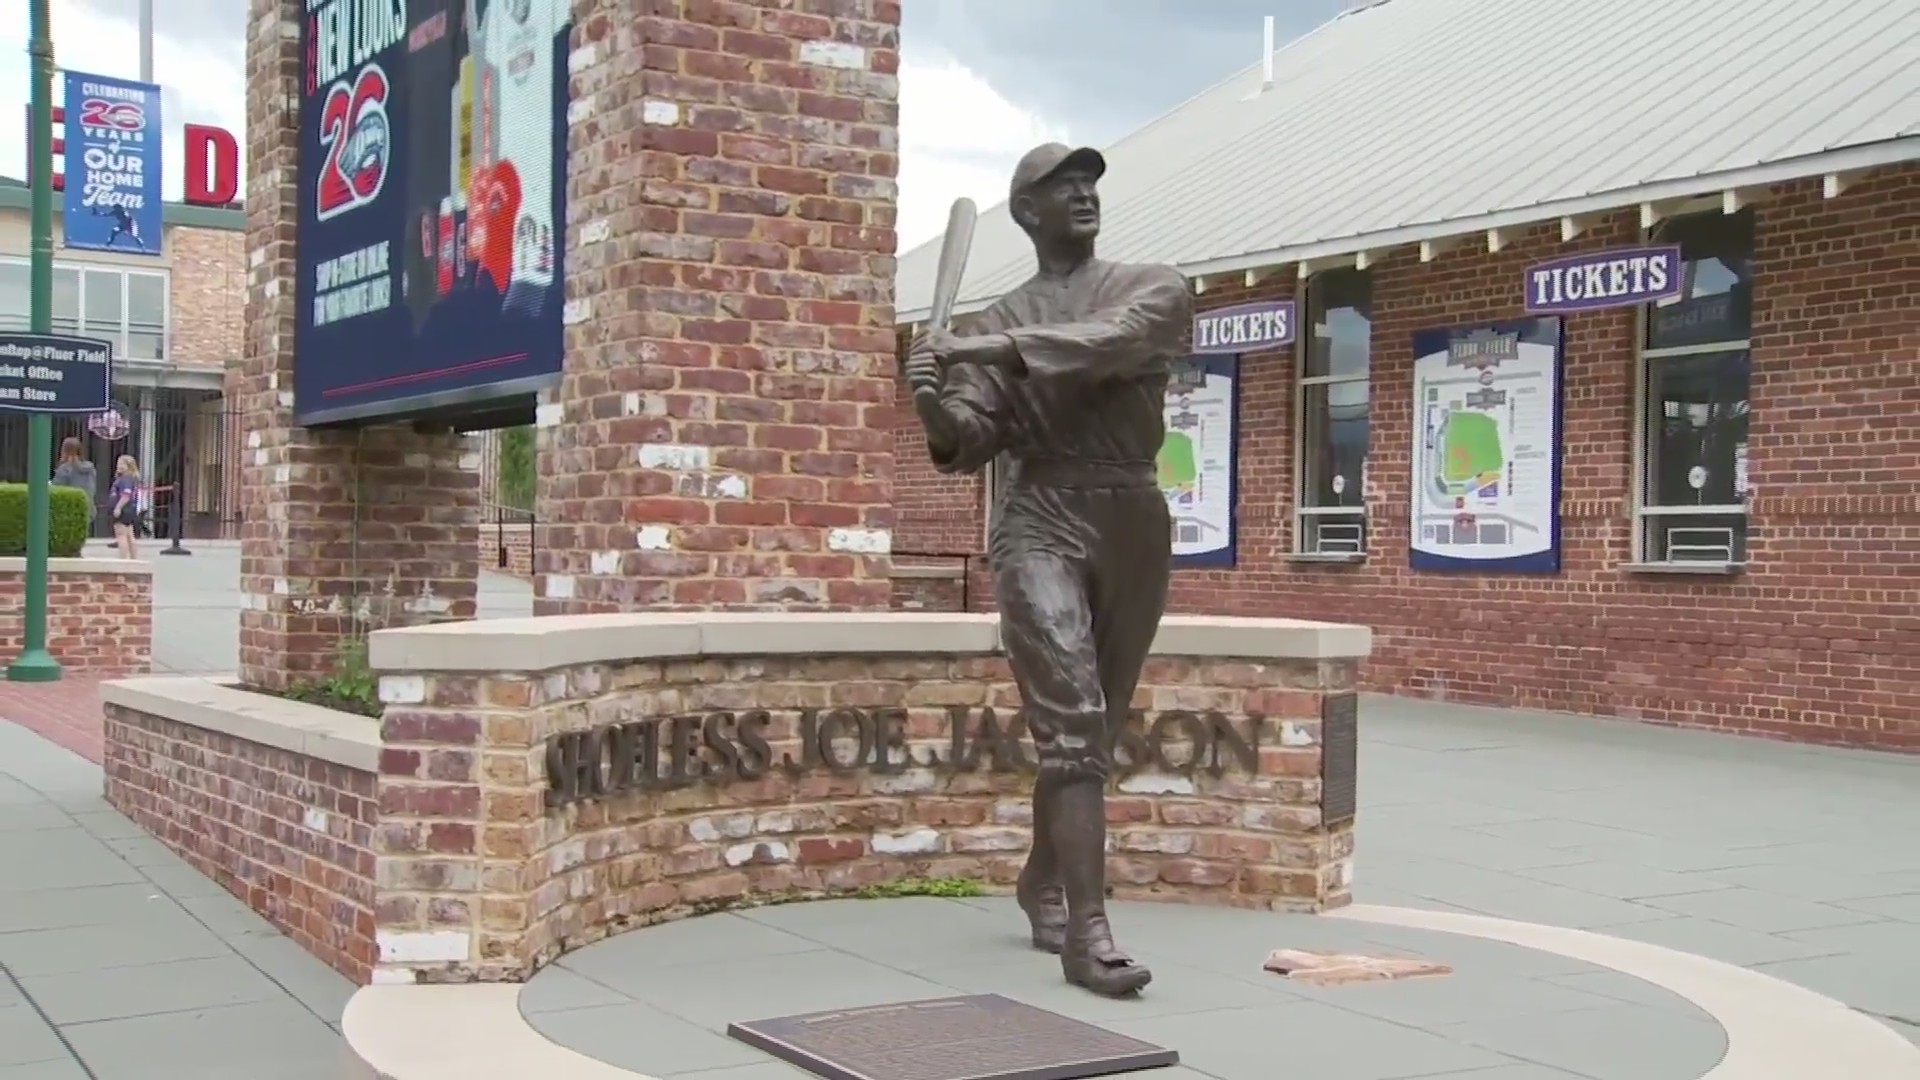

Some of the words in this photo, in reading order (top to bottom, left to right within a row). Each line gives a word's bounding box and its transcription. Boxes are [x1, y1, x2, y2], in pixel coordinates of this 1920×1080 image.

[83, 126, 144, 142] YEARS
[84, 148, 143, 173] OUR
[86, 170, 143, 188] HOME
[82, 183, 145, 209] Team
[1533, 254, 1668, 304] TICKETS
[1198, 308, 1287, 347] TICKETS
[77, 349, 106, 364] Field
[27, 365, 64, 382] Office
[22, 386, 57, 402] Store
[545, 709, 773, 802] SHOELESS
[784, 705, 912, 777] JOE
